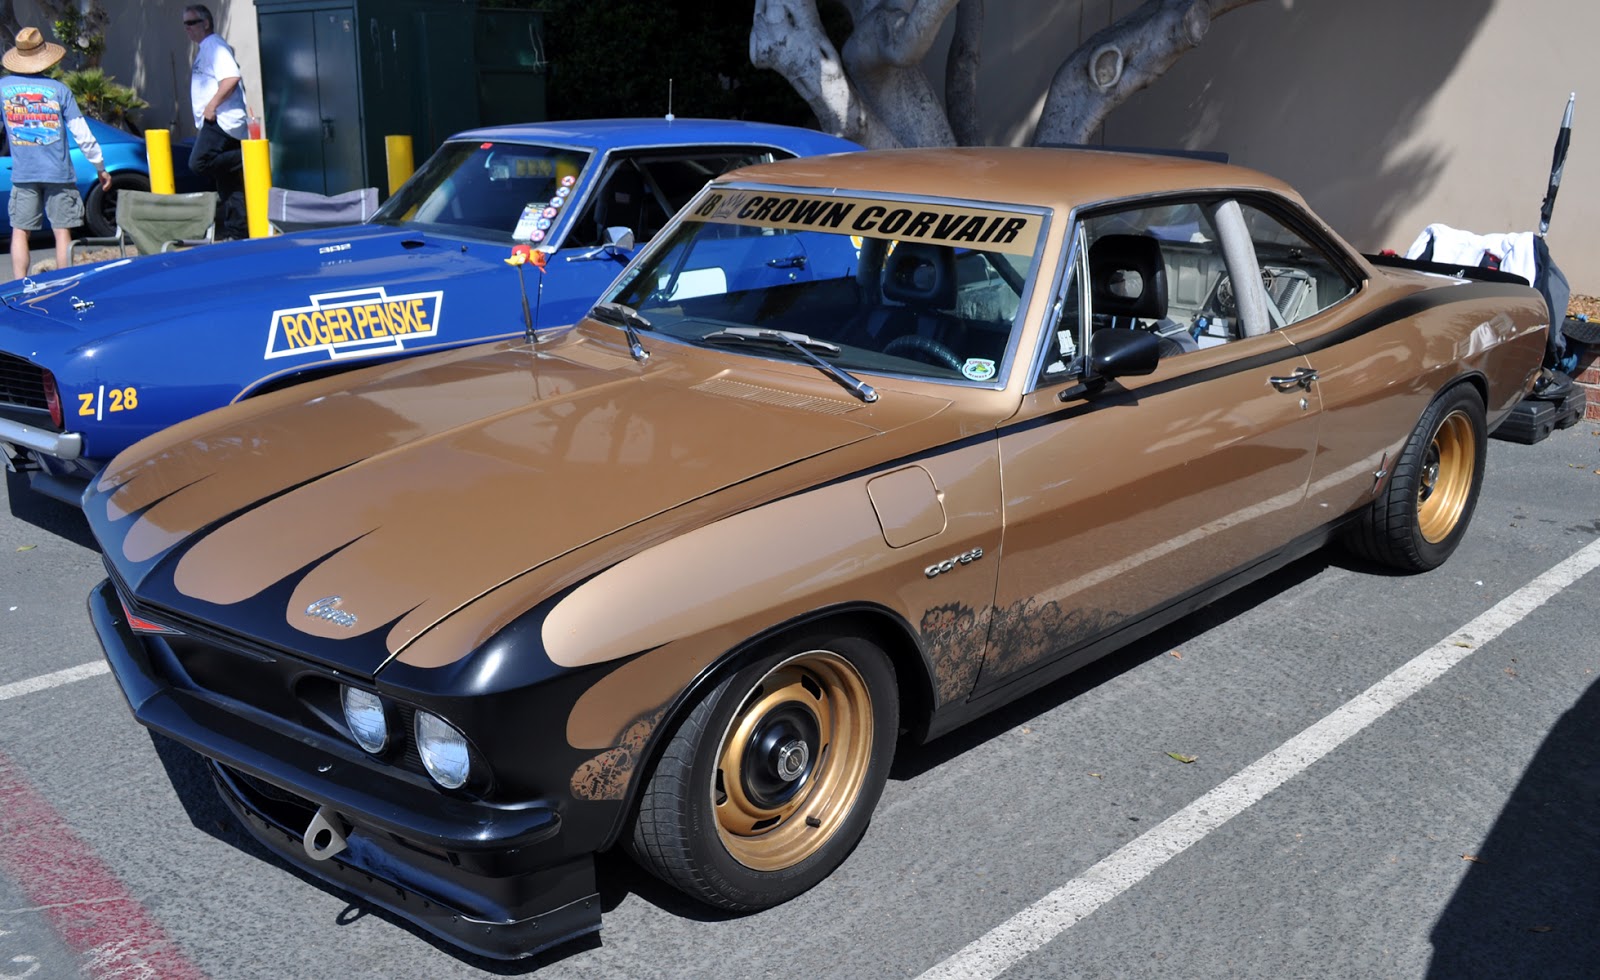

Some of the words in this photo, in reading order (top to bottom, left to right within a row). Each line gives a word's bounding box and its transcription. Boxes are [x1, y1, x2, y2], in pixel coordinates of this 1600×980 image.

[695, 193, 722, 216] 18
[736, 196, 857, 228] CROWN
[851, 206, 1028, 244] CORVAIR
[281, 308, 359, 349] ROGER
[352, 299, 432, 339] PENSKE
[78, 385, 138, 421] Z/28
